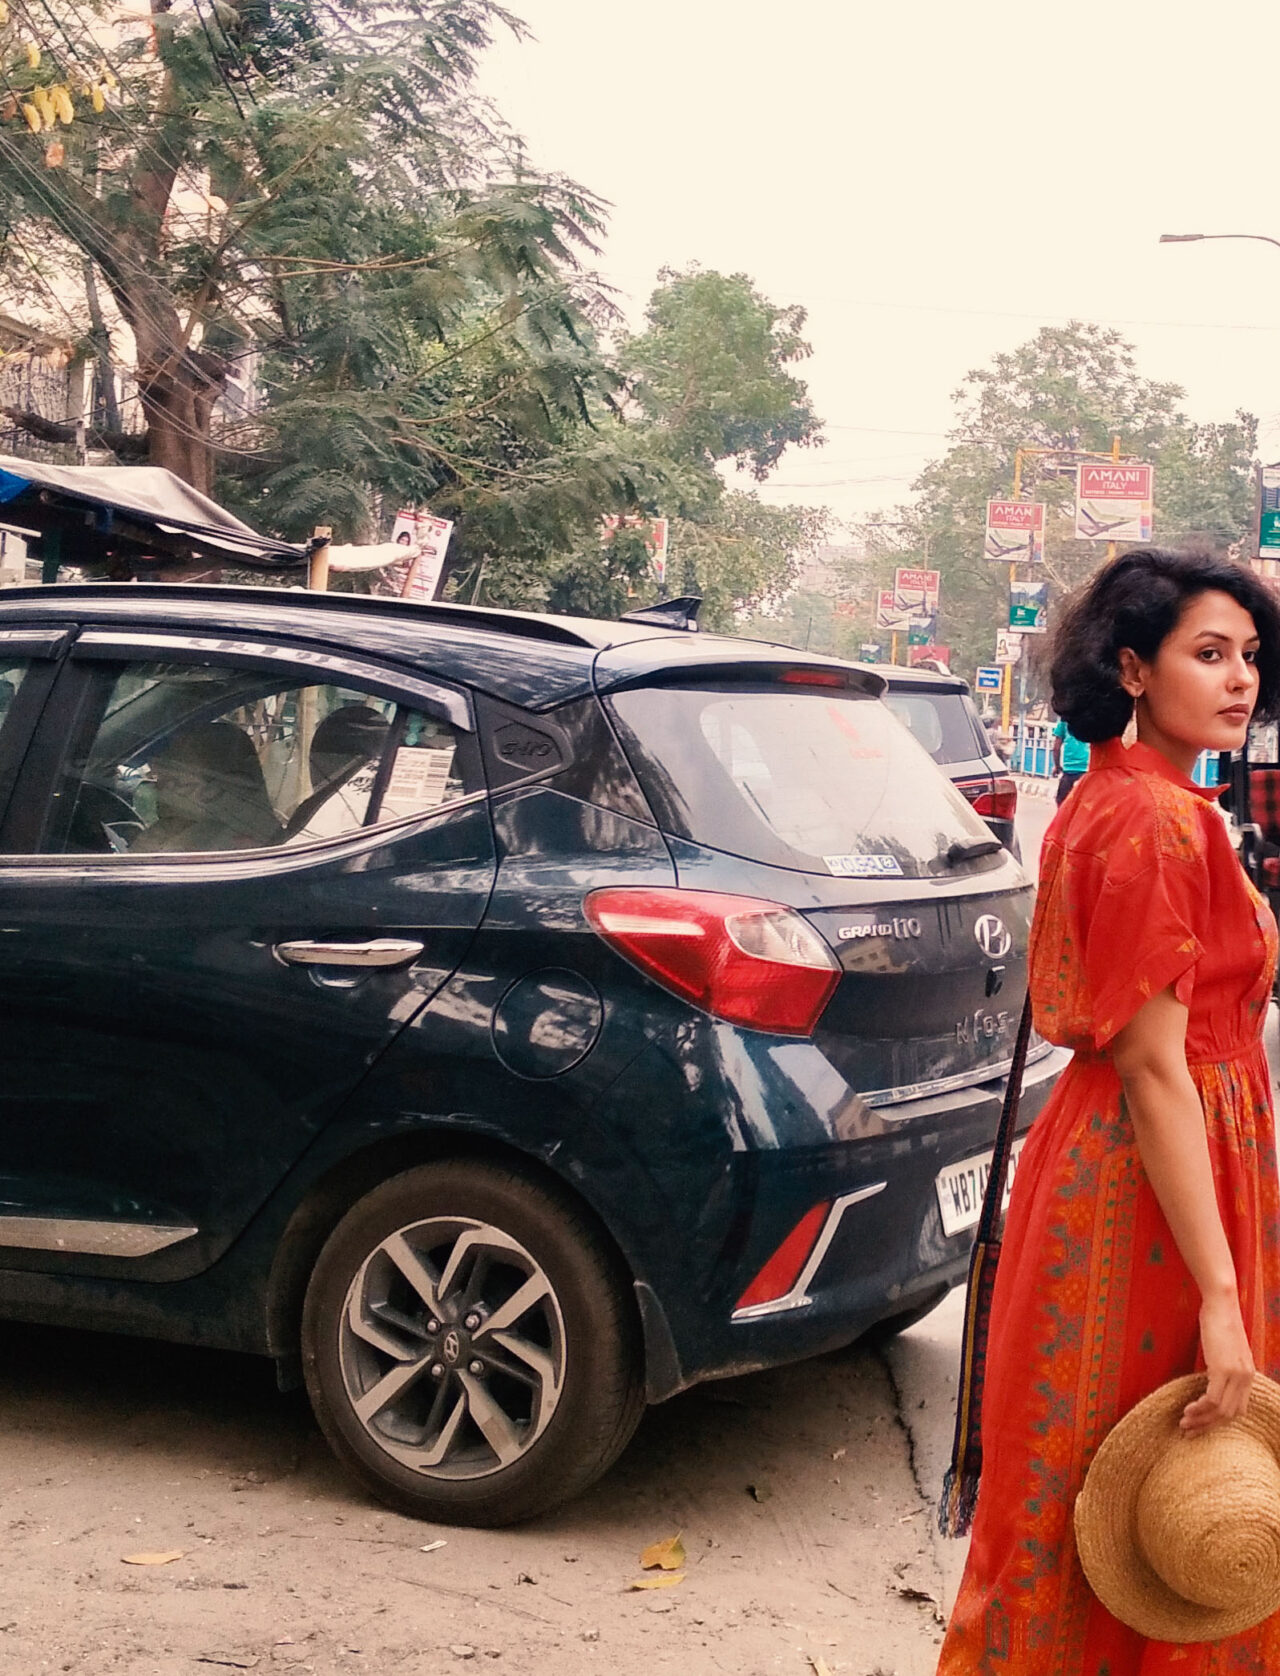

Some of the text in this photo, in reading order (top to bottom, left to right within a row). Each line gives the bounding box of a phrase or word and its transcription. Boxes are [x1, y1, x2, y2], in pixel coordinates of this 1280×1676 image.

[1088, 470, 1140, 482] AMANI
[1102, 481, 1127, 490] ITALY
[995, 506, 1032, 516] AMAN
[838, 924, 892, 940] GRAND
